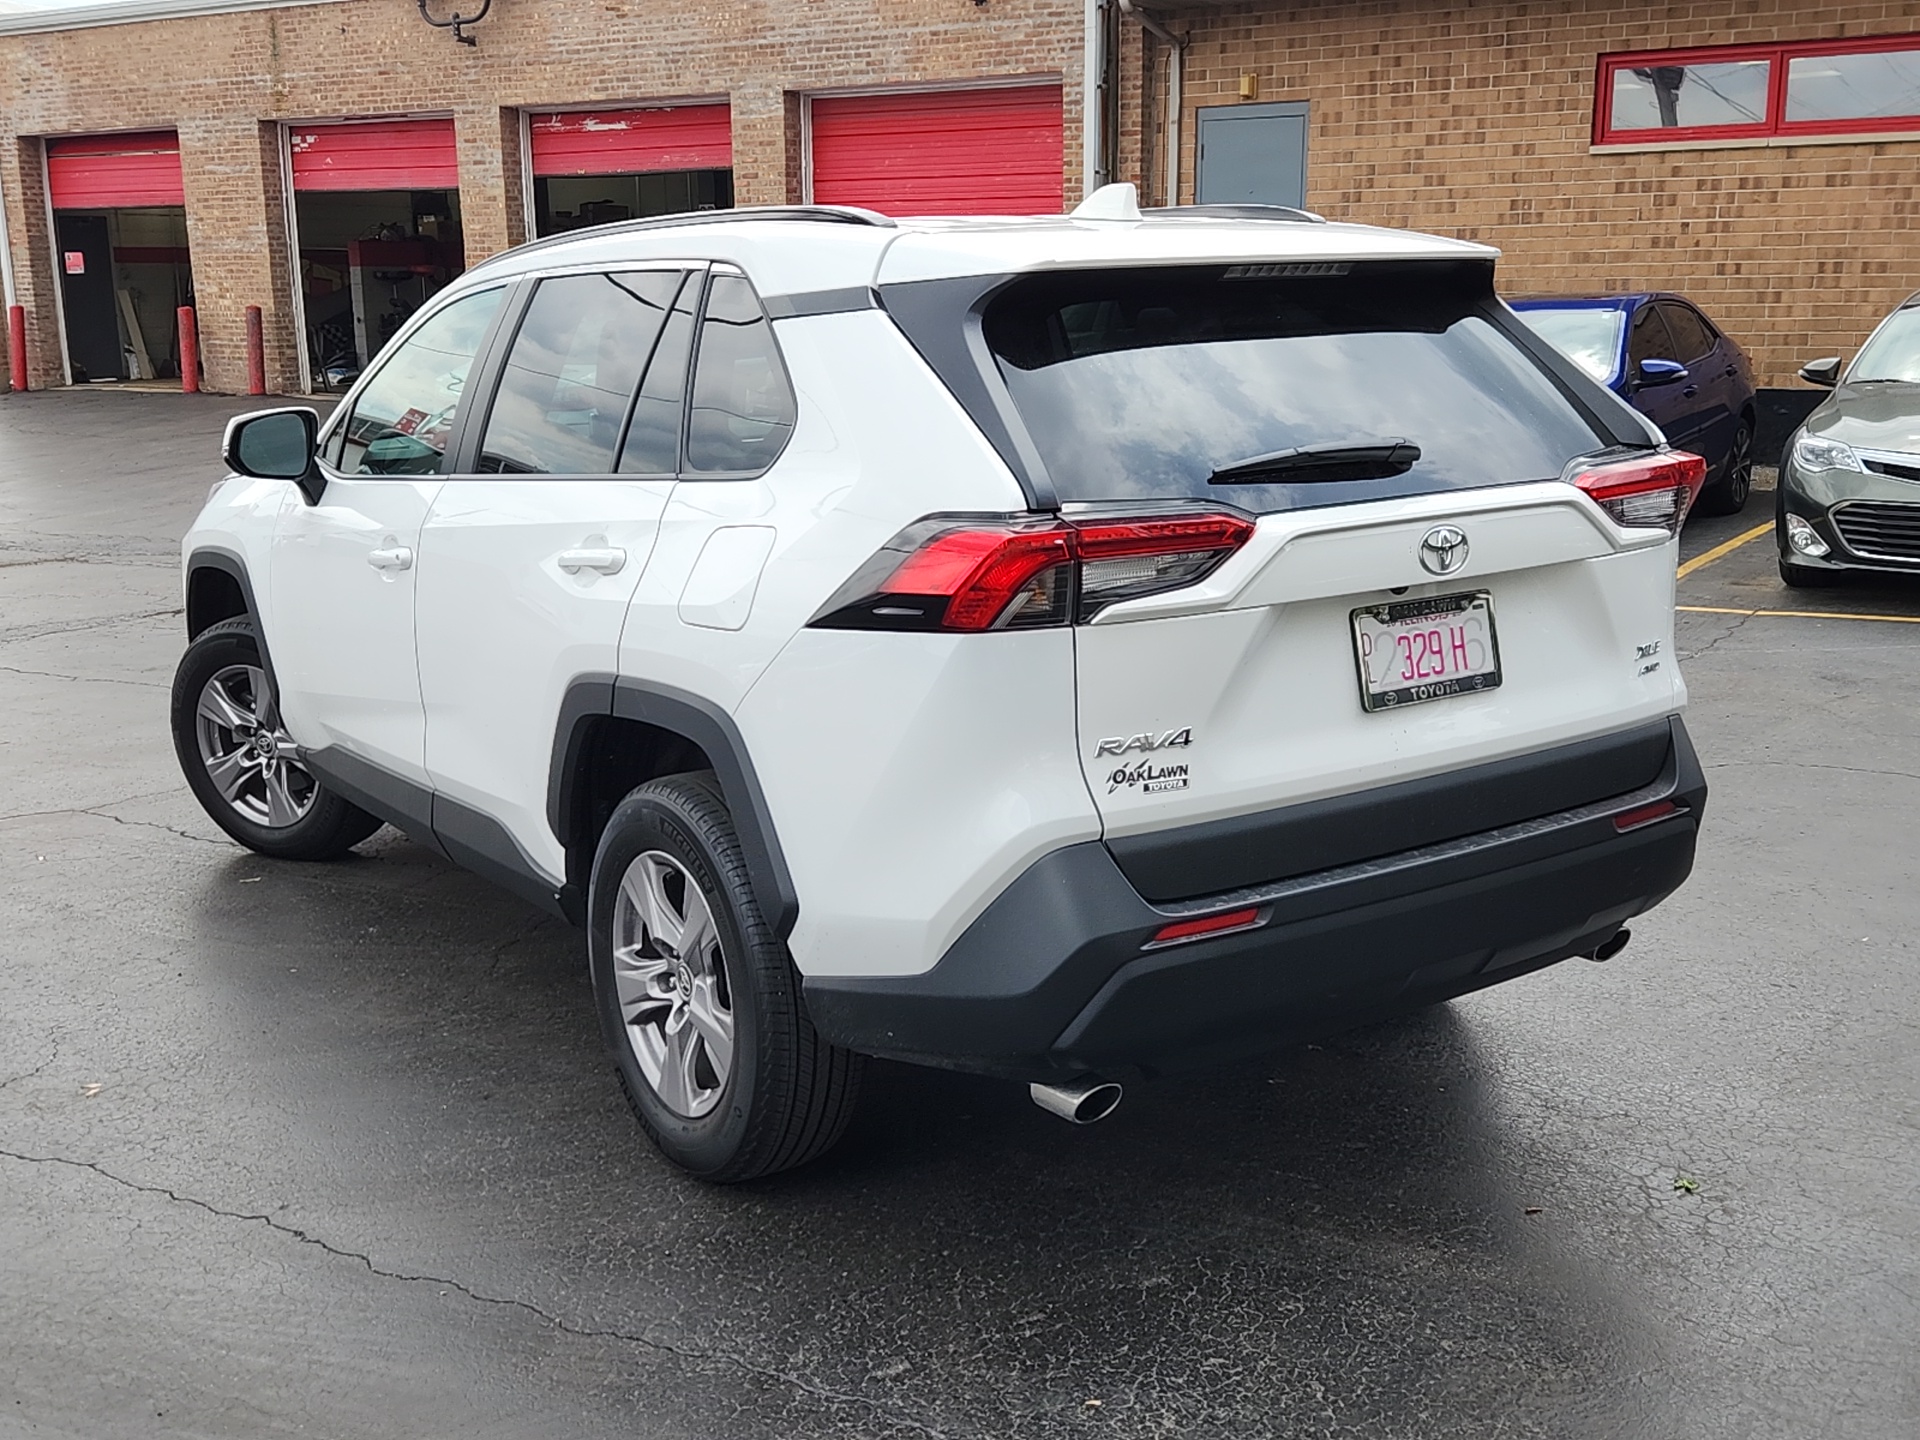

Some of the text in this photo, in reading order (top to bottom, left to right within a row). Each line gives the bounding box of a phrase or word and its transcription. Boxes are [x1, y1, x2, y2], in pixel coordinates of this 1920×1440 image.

[1397, 626, 1468, 681] 329 H
[1410, 682, 1460, 701] TOYOTA
[1094, 725, 1194, 759] RAV4
[1147, 779, 1185, 793] TOYOTA
[662, 820, 713, 892] MICHELIN
